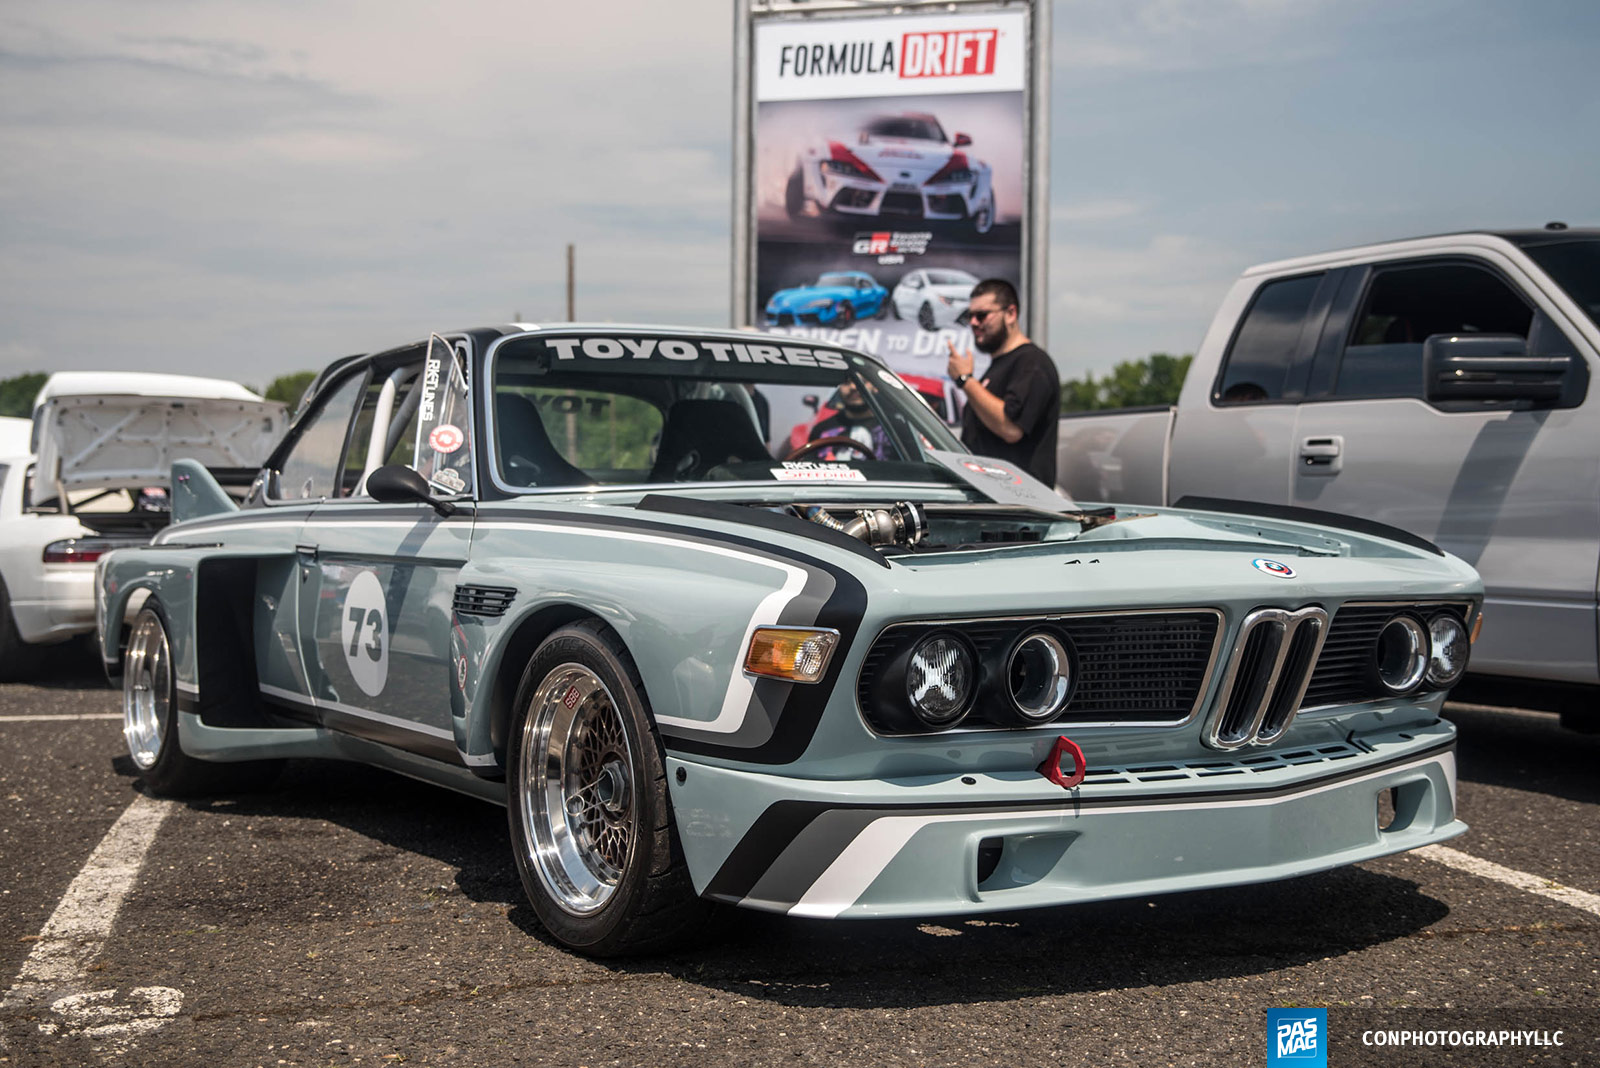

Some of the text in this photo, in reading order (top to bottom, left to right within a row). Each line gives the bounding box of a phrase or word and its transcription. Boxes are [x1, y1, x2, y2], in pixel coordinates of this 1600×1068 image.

[780, 31, 995, 77] FORMULA DRIFT
[545, 338, 849, 370] TOYO TIRES
[348, 606, 383, 662] 73
[565, 687, 580, 709] BBS
